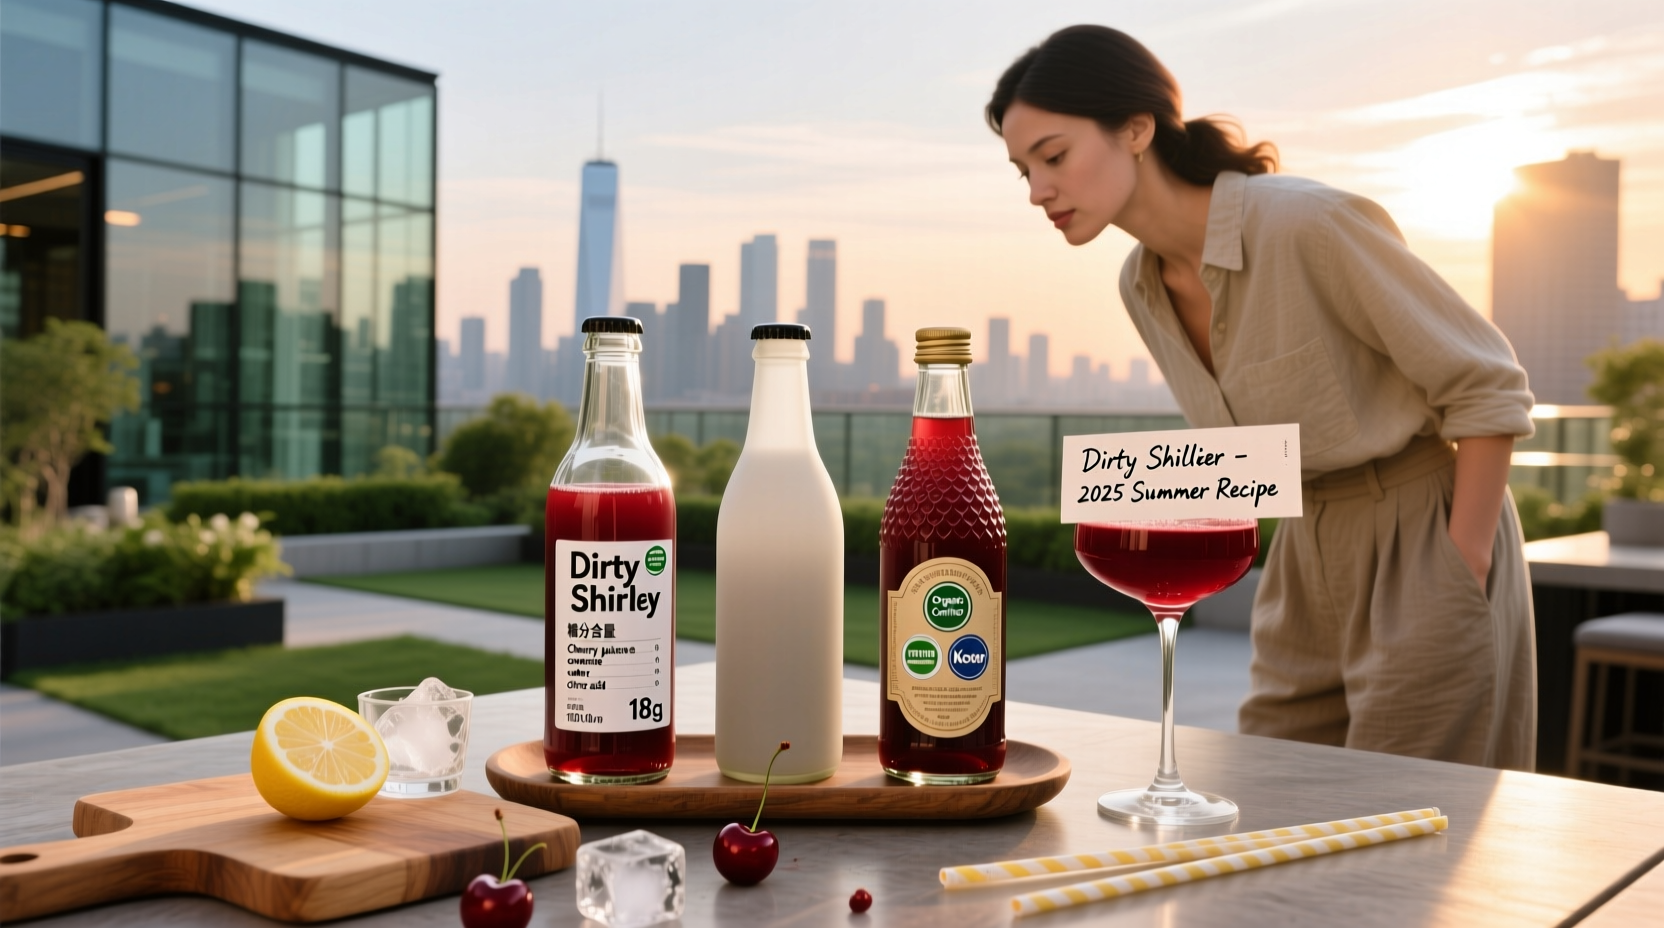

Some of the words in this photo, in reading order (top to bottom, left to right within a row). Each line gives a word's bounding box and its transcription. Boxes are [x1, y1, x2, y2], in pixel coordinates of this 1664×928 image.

[1082, 447, 1137, 479] Dirty
[1077, 483, 1125, 503] 2025
[1130, 480, 1210, 503] Summer
[1216, 477, 1279, 508] Recipe
[571, 551, 640, 588] Dirty
[571, 584, 661, 619] Shirley
[629, 697, 663, 723] 18g
